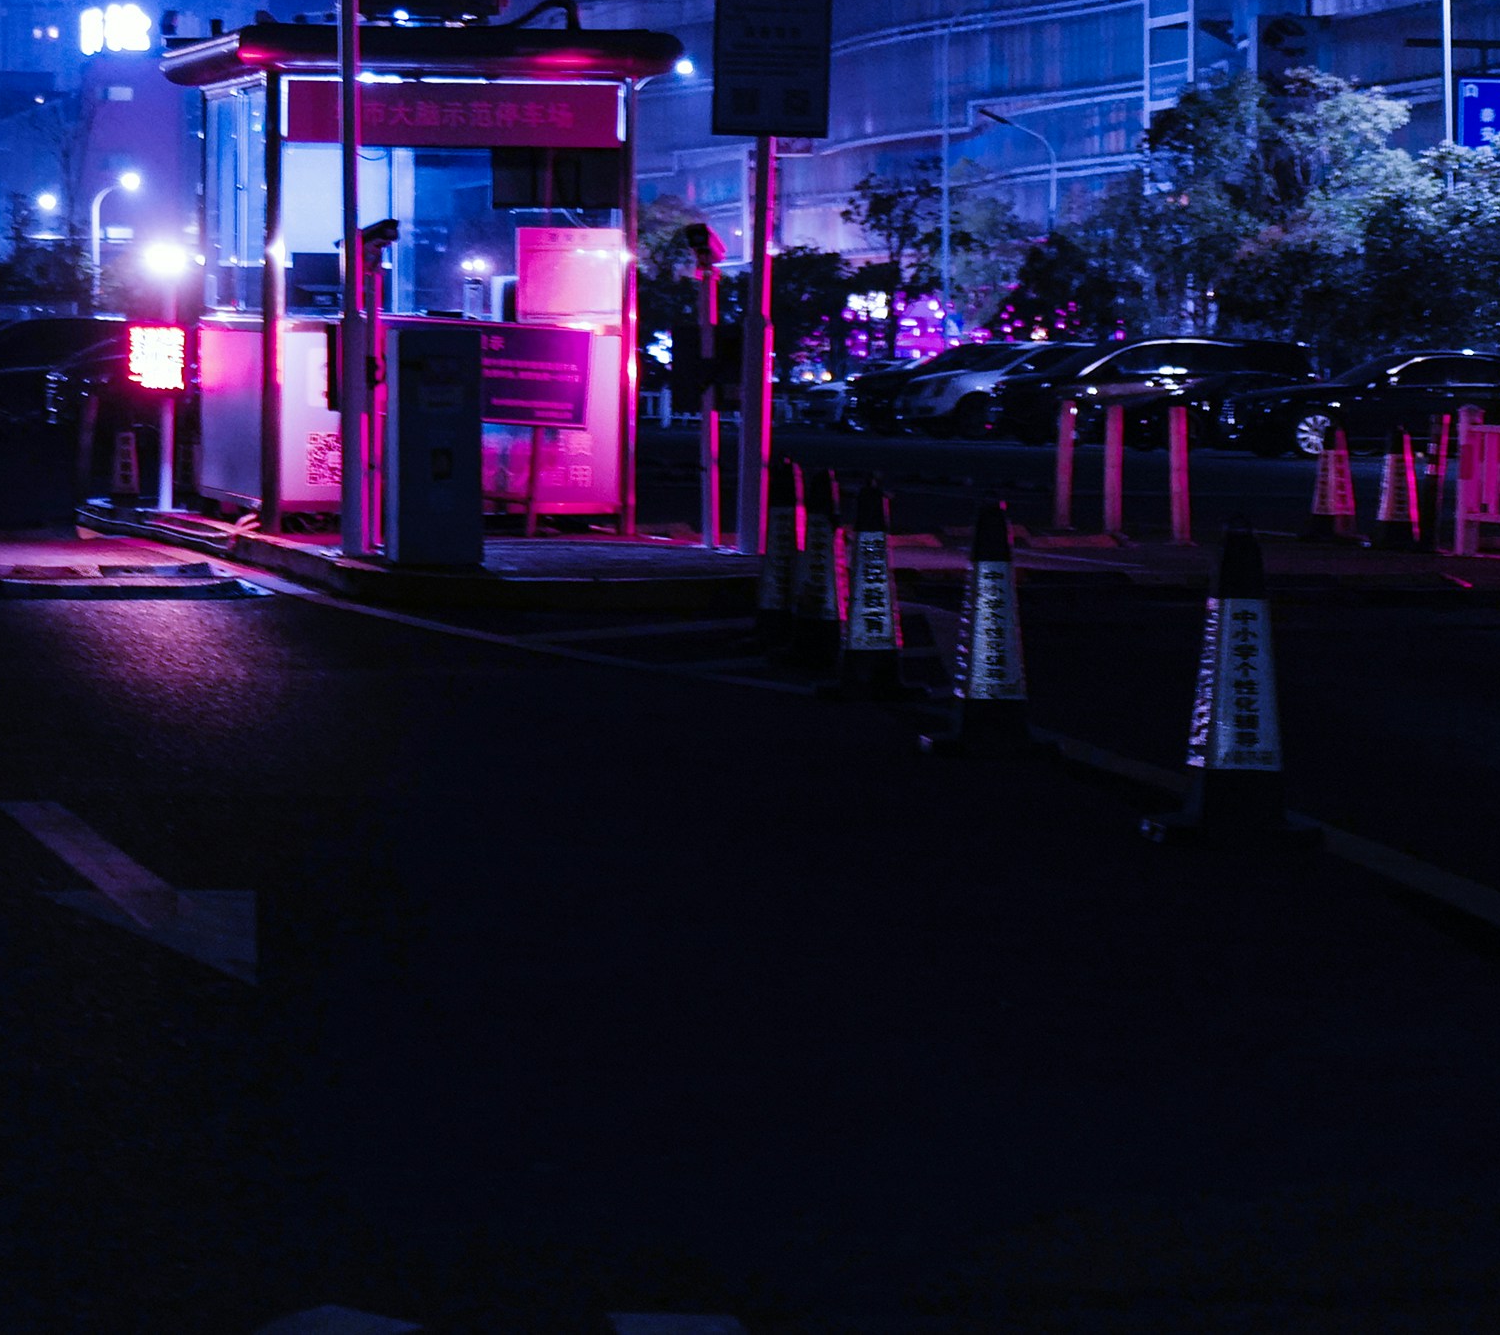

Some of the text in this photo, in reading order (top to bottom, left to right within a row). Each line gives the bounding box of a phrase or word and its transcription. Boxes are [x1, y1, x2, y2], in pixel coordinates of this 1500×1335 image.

[335, 100, 576, 130] 市大脑示范停车场
